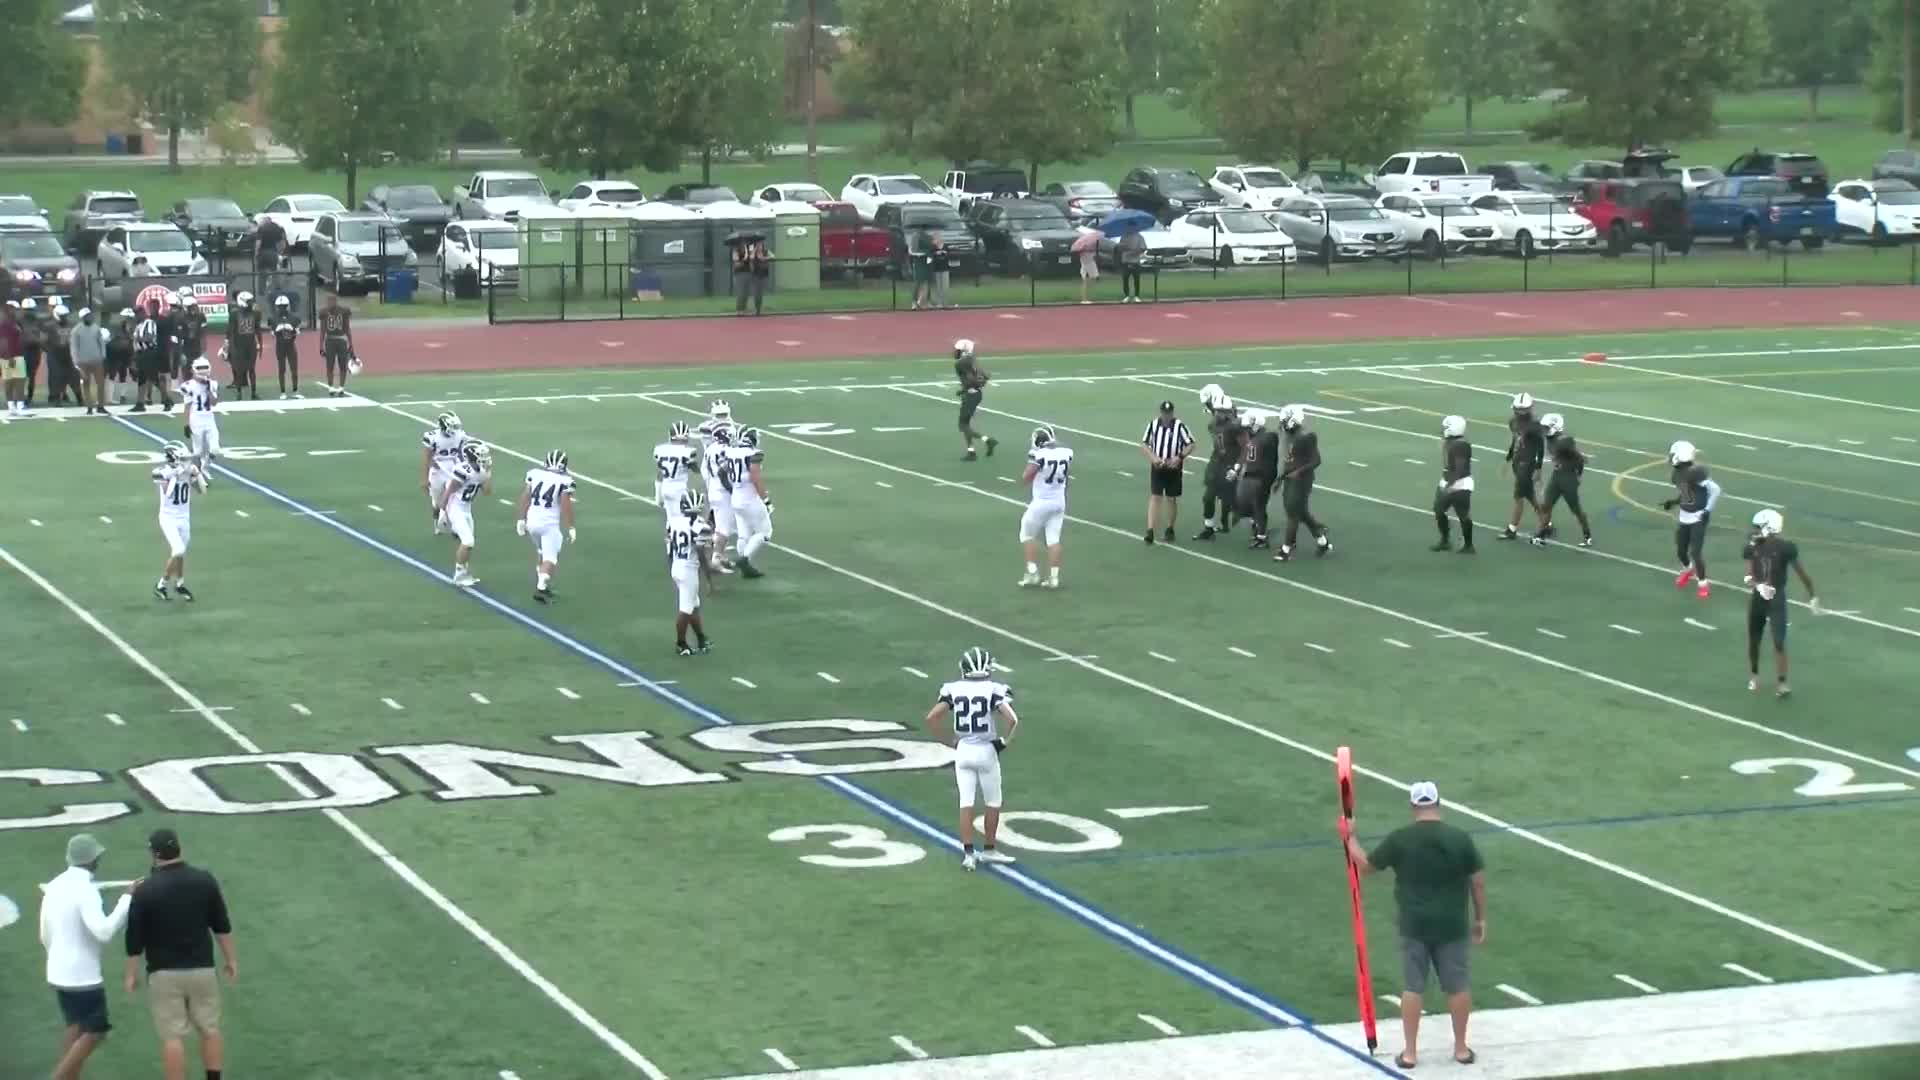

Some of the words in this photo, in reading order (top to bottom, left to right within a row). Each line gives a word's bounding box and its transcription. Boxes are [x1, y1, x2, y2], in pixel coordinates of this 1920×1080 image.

[657, 455, 680, 480] 57
[1045, 459, 1069, 485] 73
[530, 481, 557, 509] 44
[954, 695, 990, 733] 22
[1730, 746, 1920, 797] 2
[768, 811, 1123, 868] 30
